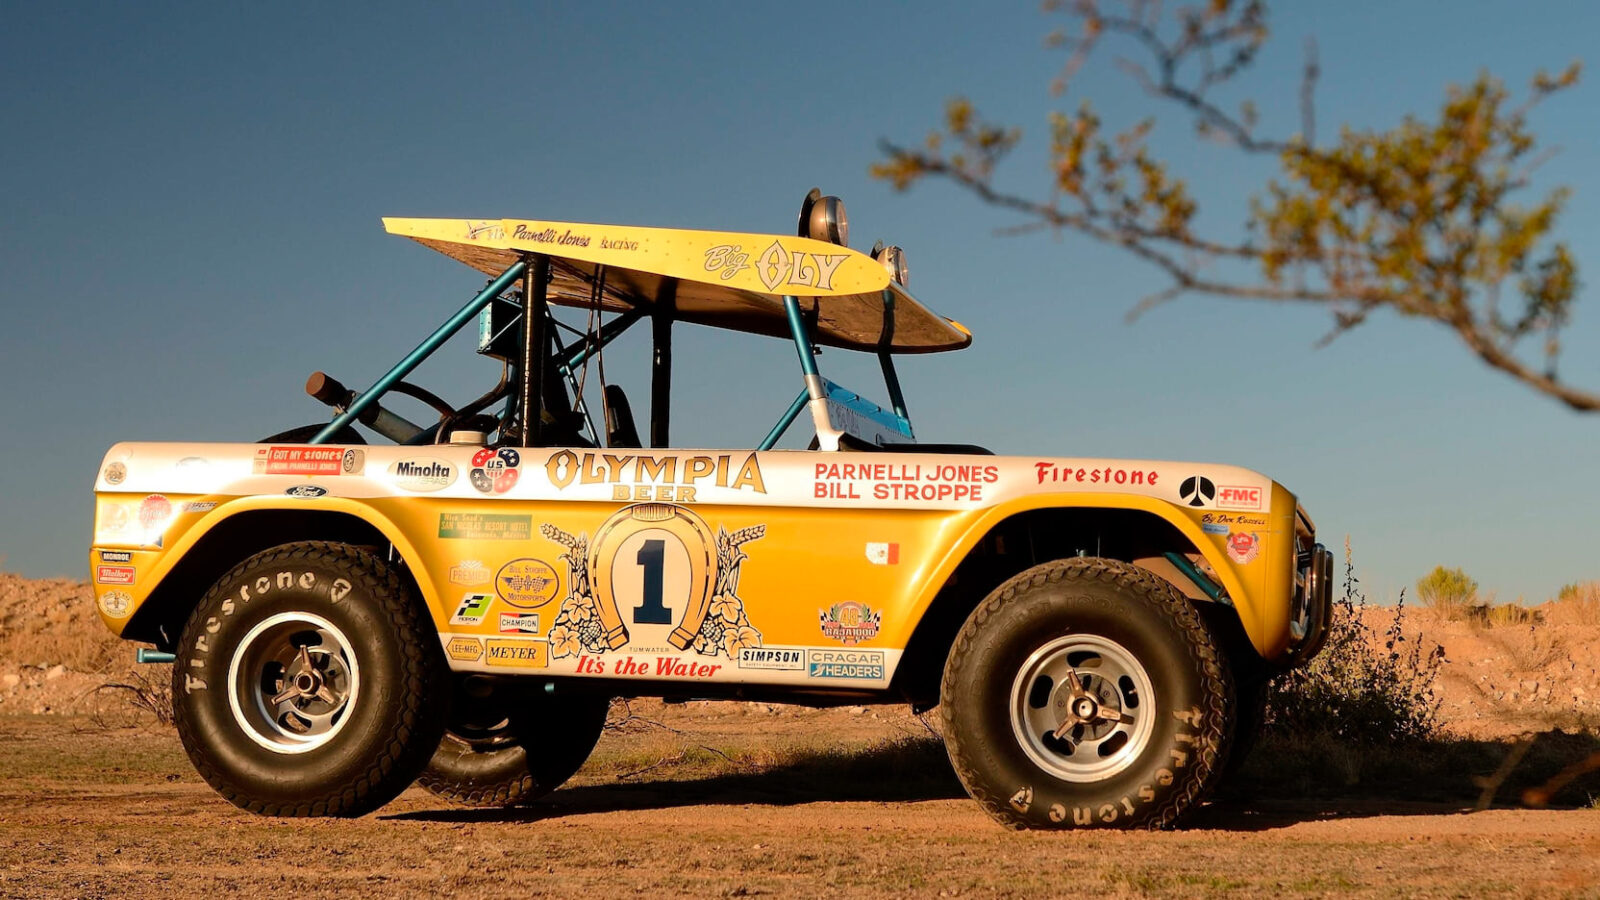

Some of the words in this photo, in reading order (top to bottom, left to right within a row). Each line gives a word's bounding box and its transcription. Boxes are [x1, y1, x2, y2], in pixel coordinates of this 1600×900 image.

[513, 224, 557, 244] Parnelli
[557, 229, 591, 247] Jones
[600, 237, 639, 250] RACING
[704, 244, 750, 280] Big
[755, 240, 851, 292] OLY
[274, 450, 289, 460] GOT
[290, 450, 301, 460] MY
[397, 462, 450, 478] Minolta
[544, 449, 768, 495] OLYMPIA
[815, 463, 921, 481] PARNELLI
[926, 465, 999, 483] JONES
[1034, 462, 1159, 486] Firestone
[612, 484, 697, 502] BEER
[814, 482, 861, 499] BILL
[873, 483, 983, 501] STROPPE
[1219, 488, 1259, 502] FMC
[103, 552, 130, 561] MONROE
[453, 570, 490, 581] PREMIER
[633, 539, 673, 625] 1
[502, 618, 537, 628] CHAMPION
[185, 571, 316, 695] Firestone
[489, 647, 537, 660] MEYER
[742, 650, 800, 663] SIMPSON
[811, 652, 881, 664] CRAGAR
[575, 655, 605, 675] It's
[614, 656, 649, 675] the
[656, 657, 722, 677] Water
[825, 665, 881, 678] HEADERS
